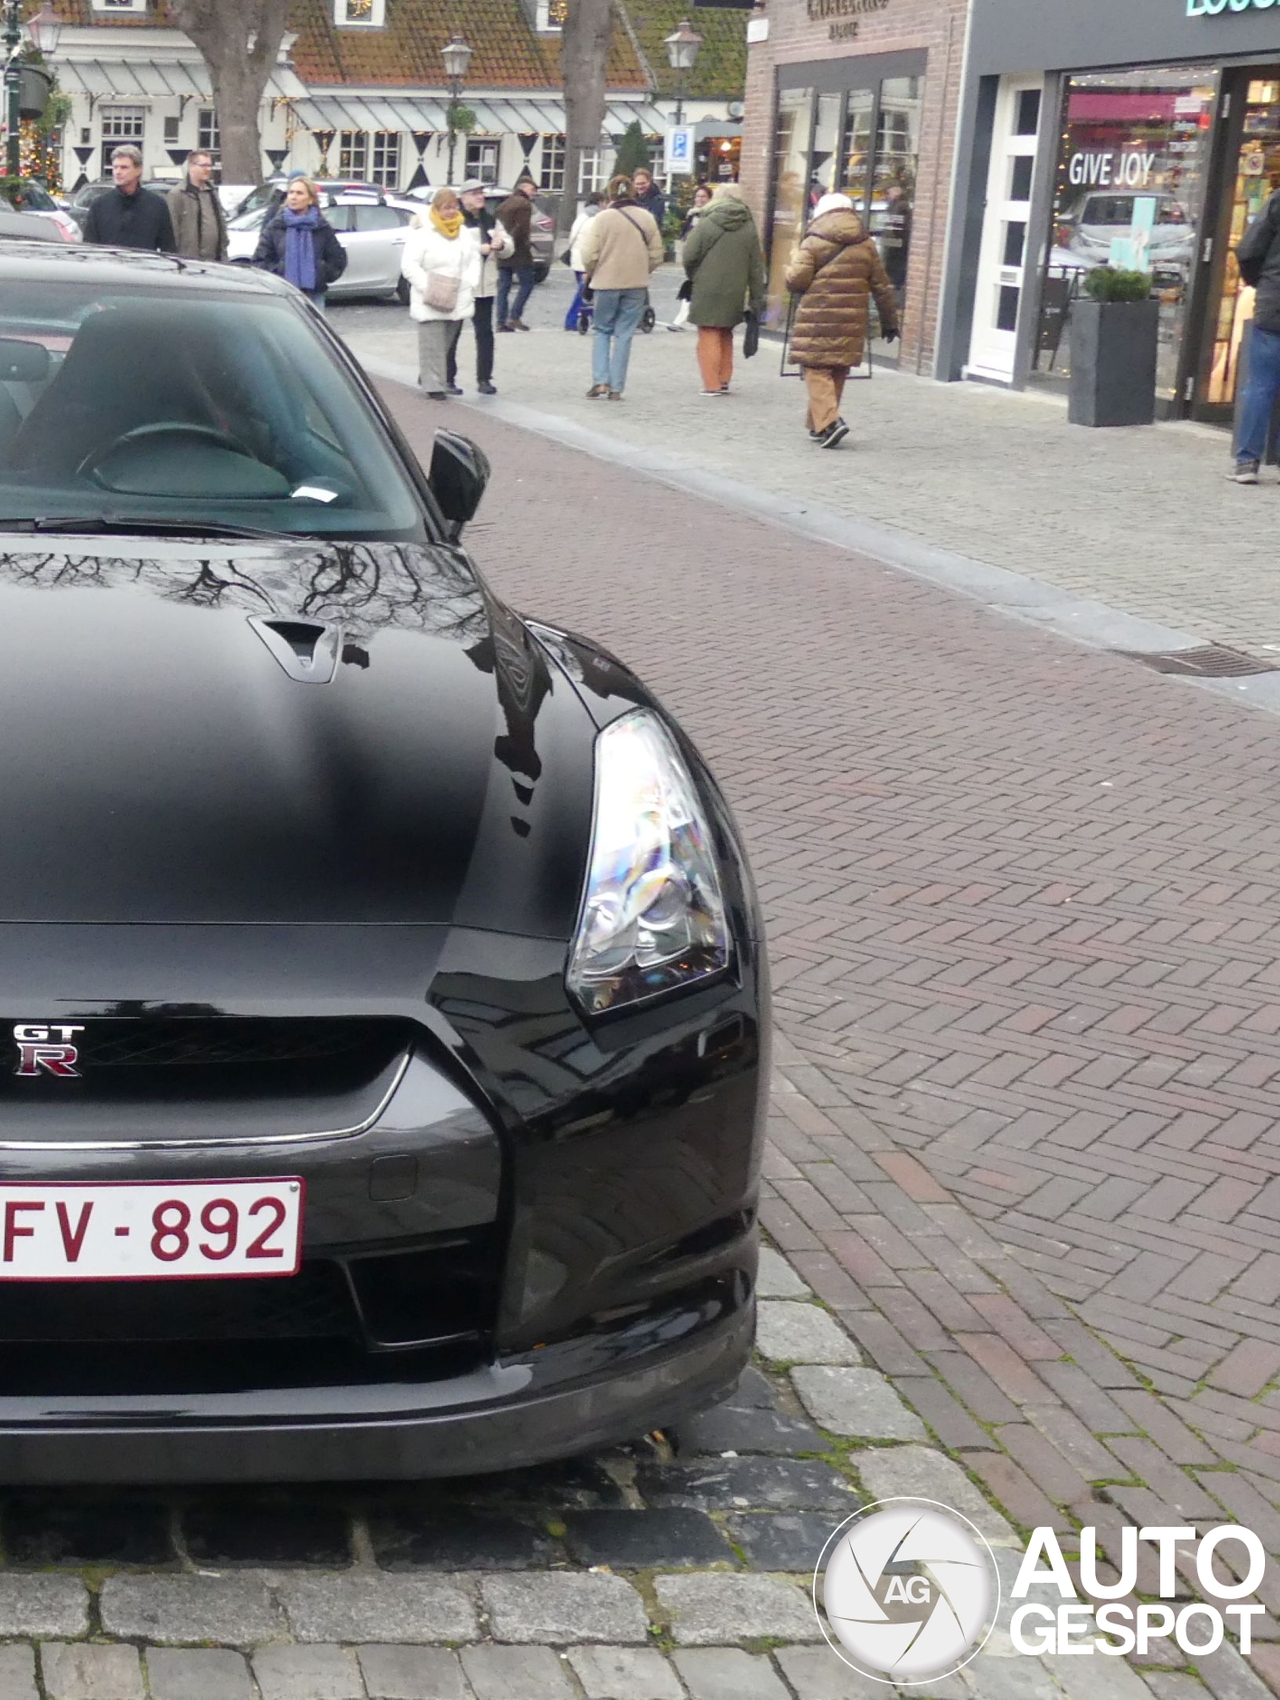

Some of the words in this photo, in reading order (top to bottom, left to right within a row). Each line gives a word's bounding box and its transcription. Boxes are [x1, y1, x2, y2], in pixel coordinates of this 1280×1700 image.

[1070, 152, 1113, 185] GIVE
[1114, 152, 1156, 185] JOY
[13, 1024, 85, 1042] GT
[15, 1043, 82, 1077] R
